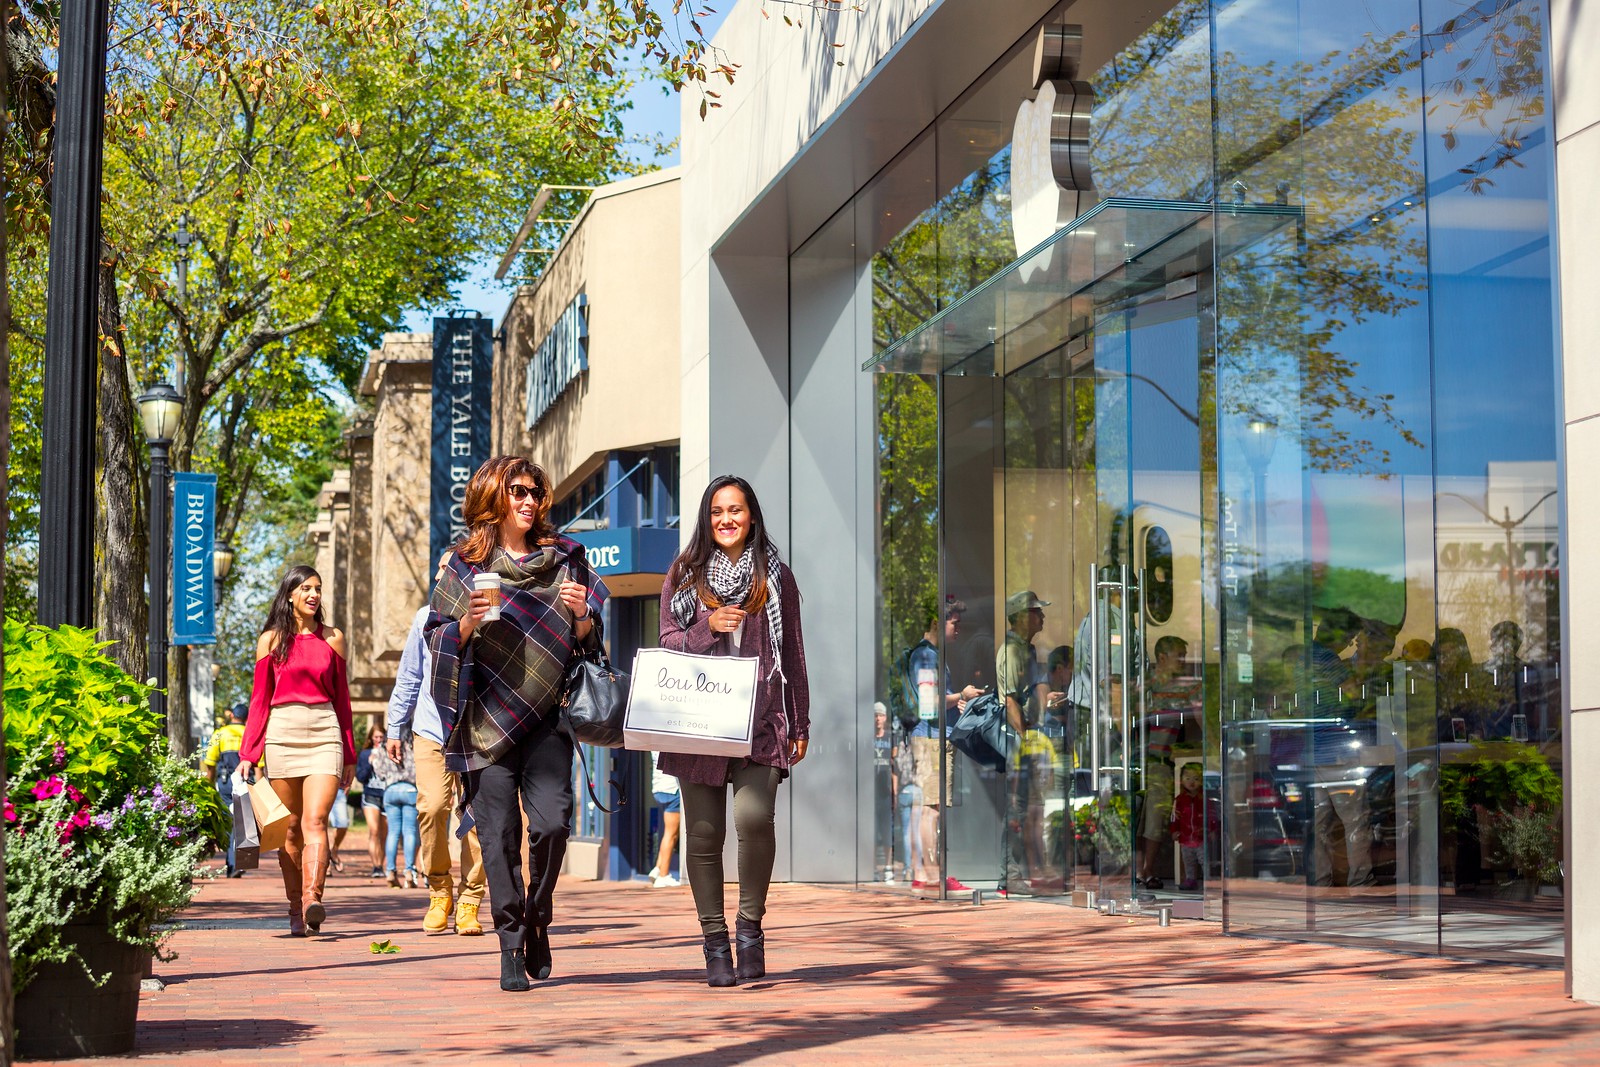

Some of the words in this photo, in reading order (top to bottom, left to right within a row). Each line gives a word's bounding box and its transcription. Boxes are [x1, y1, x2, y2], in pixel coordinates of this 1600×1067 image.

[452, 330, 473, 385] THE
[451, 391, 472, 457] YALE
[449, 464, 471, 547] BOOK
[185, 493, 205, 625] BROADWAY
[655, 667, 692, 691] lou
[695, 672, 732, 694] lou
[667, 719, 684, 727] est.
[687, 721, 709, 730] 2004
